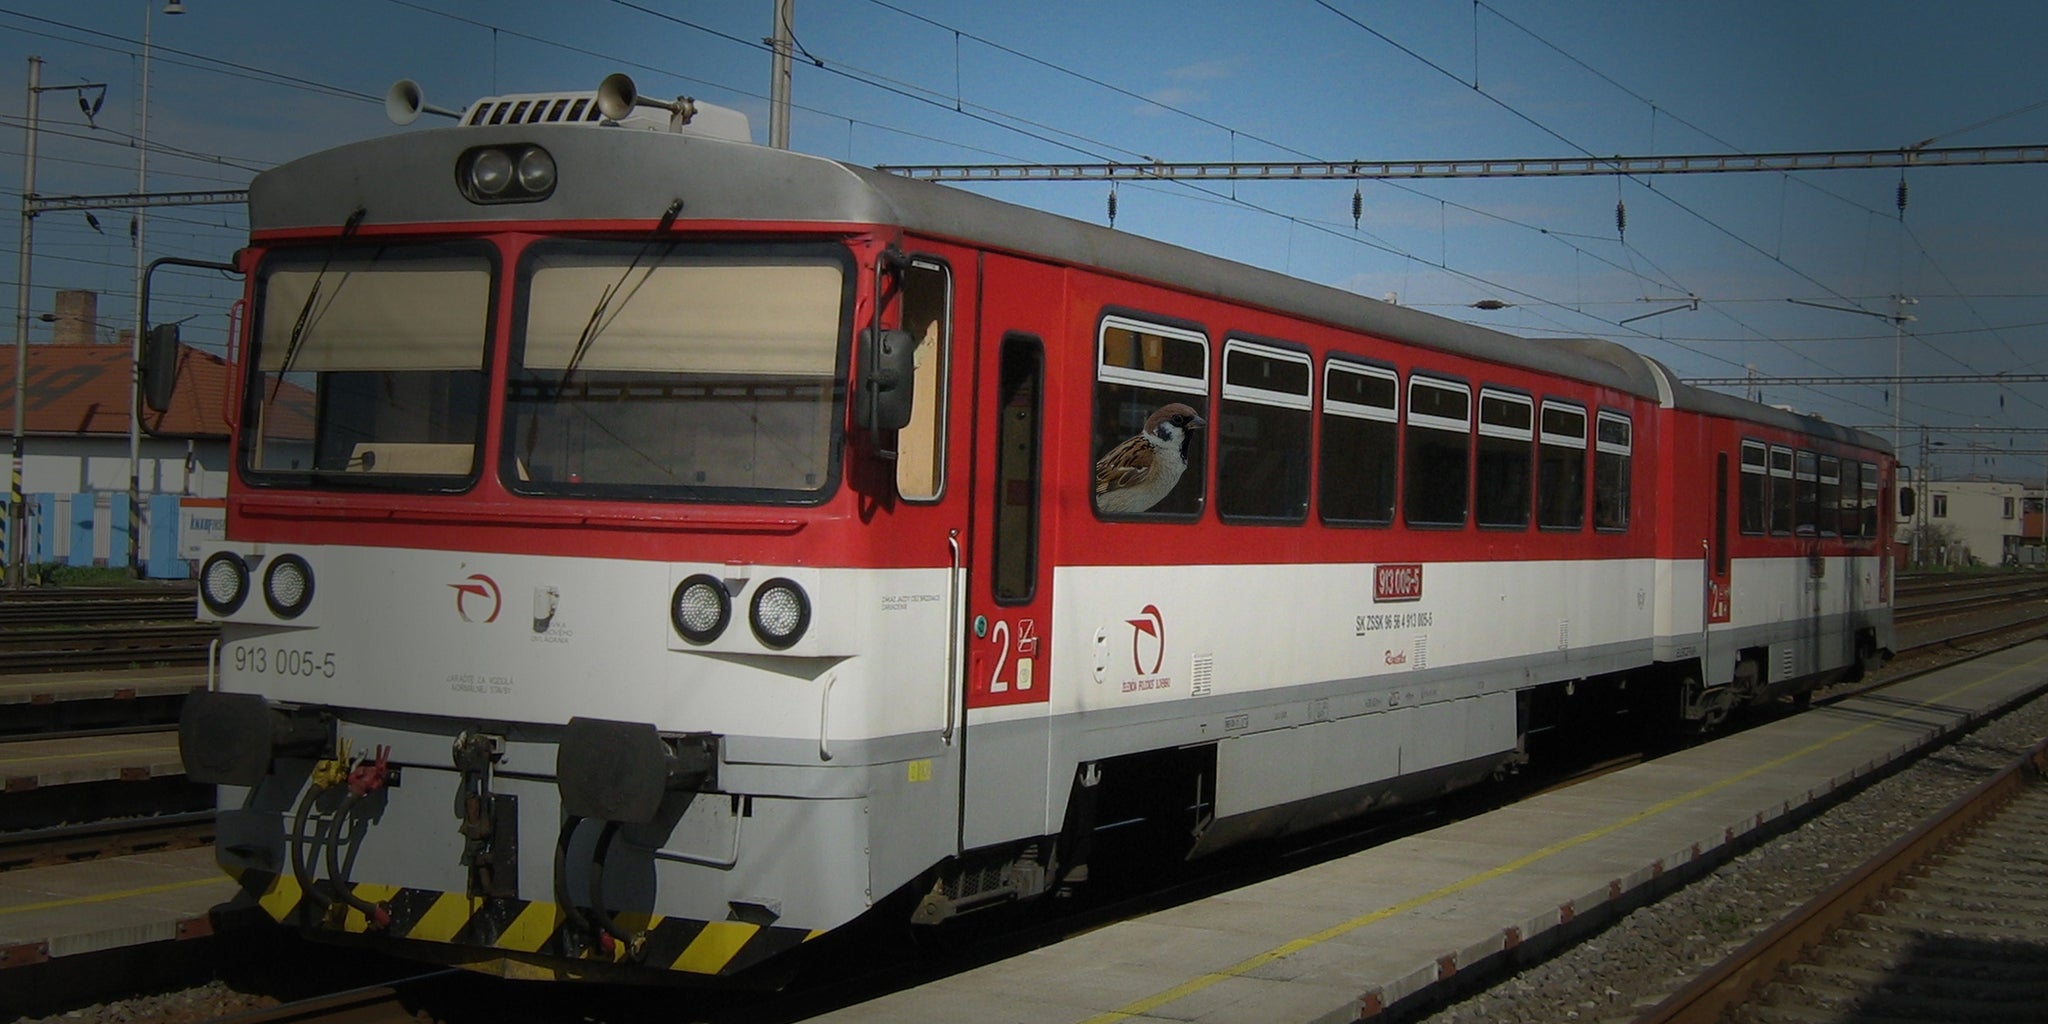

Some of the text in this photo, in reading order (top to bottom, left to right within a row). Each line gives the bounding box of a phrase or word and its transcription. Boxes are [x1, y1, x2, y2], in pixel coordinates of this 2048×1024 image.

[1379, 568, 1420, 595] 913 005-5
[235, 646, 336, 678] 913 005-5
[990, 620, 1010, 693] 2
